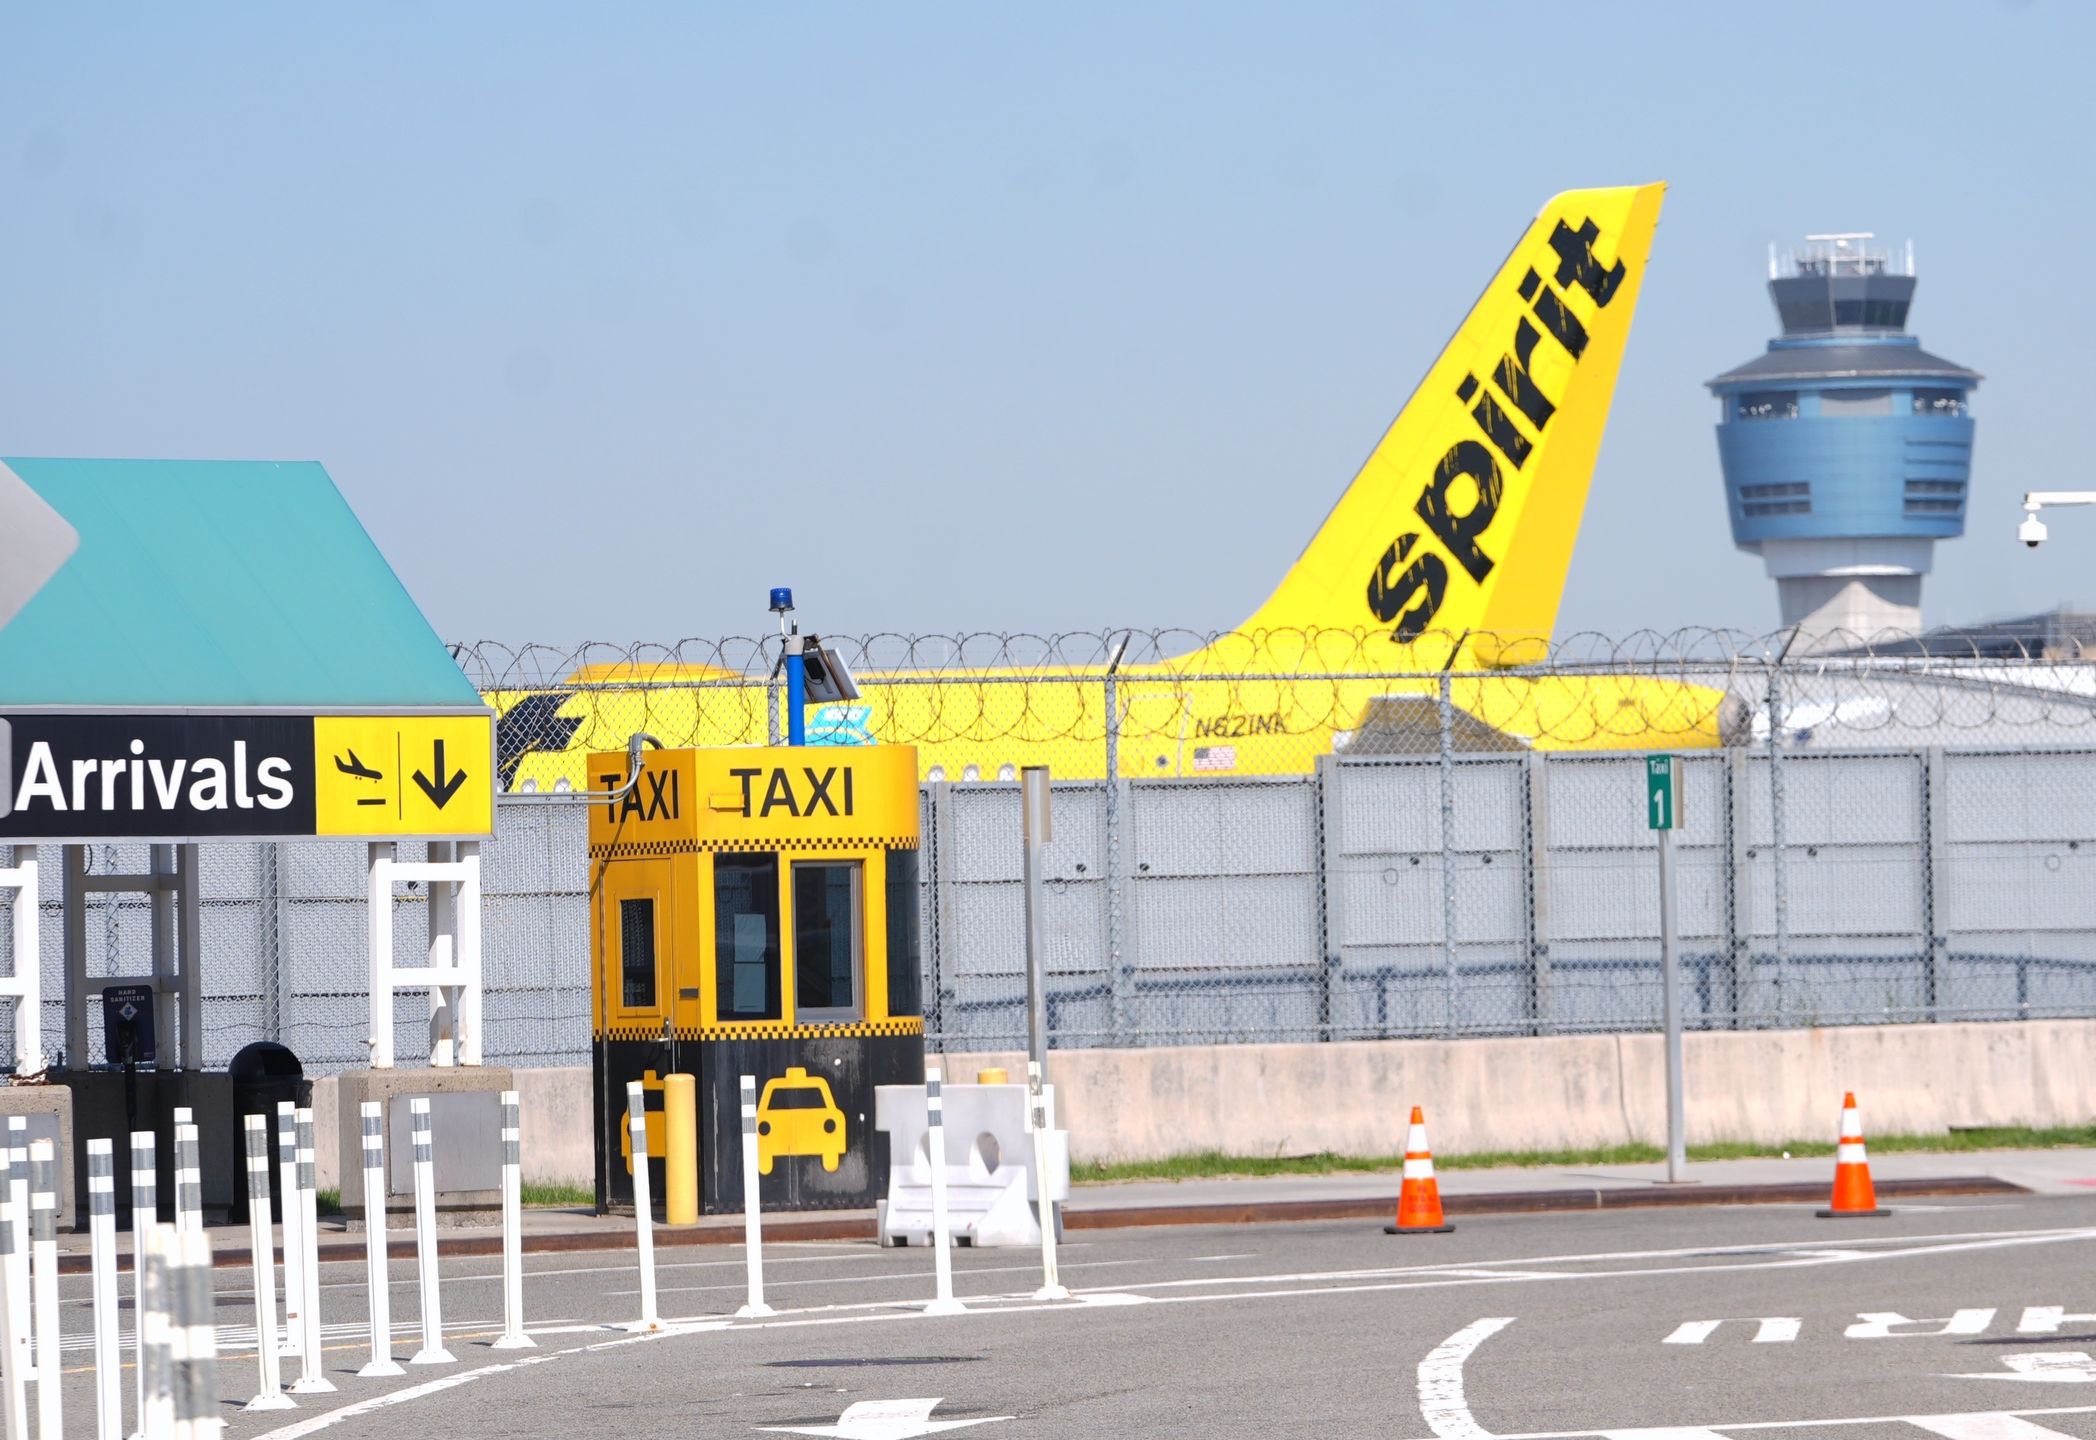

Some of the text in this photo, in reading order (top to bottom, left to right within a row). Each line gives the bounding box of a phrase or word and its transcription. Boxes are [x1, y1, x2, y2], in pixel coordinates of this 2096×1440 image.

[1367, 216, 1626, 644] spirit
[14, 739, 294, 811] Arrivals
[1649, 758, 1669, 775] Taxi
[600, 769, 680, 824] TAXI
[729, 767, 853, 818] TAXI
[1653, 789, 1664, 828] 1
[110, 995, 145, 1003] SANITIZER
